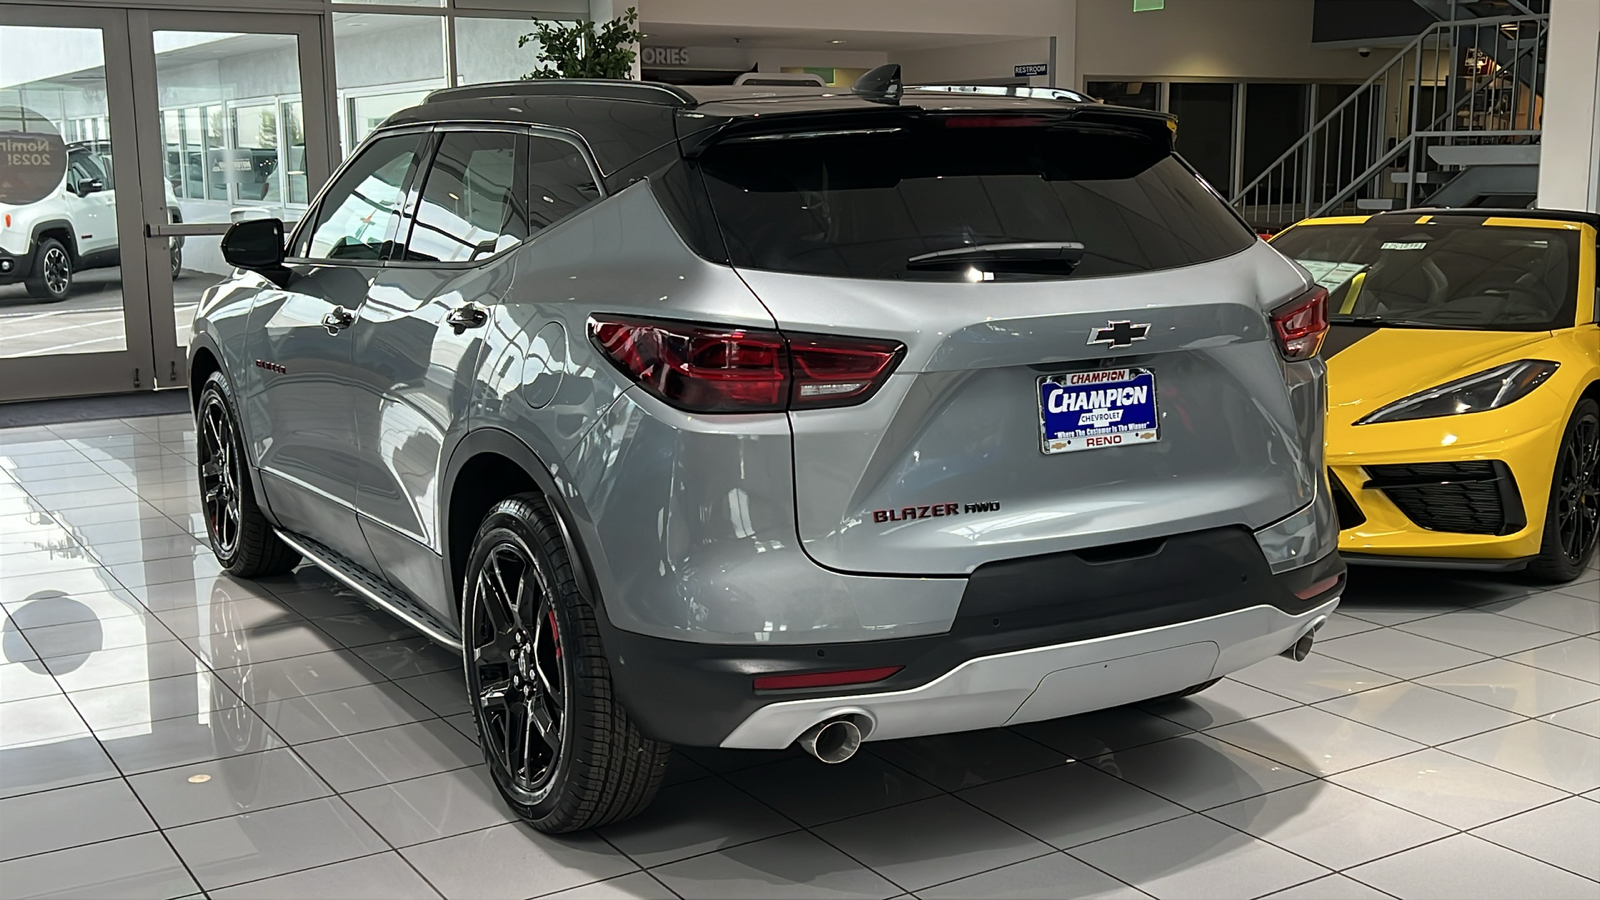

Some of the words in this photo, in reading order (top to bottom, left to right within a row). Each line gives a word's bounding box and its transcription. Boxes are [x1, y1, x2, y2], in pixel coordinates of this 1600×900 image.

[641, 47, 689, 65] ORIES
[1015, 65, 1046, 74] RESTROOM
[1070, 370, 1126, 384] CHAMPION
[1048, 385, 1148, 413] CHAMPION
[1081, 411, 1120, 423] CHEVROLET
[1075, 429, 1085, 437] The
[1086, 426, 1112, 436] Customer
[1118, 424, 1128, 432] The
[1086, 435, 1122, 447] RENO
[873, 503, 960, 523] BLAZER
[964, 500, 1000, 514] AWD
